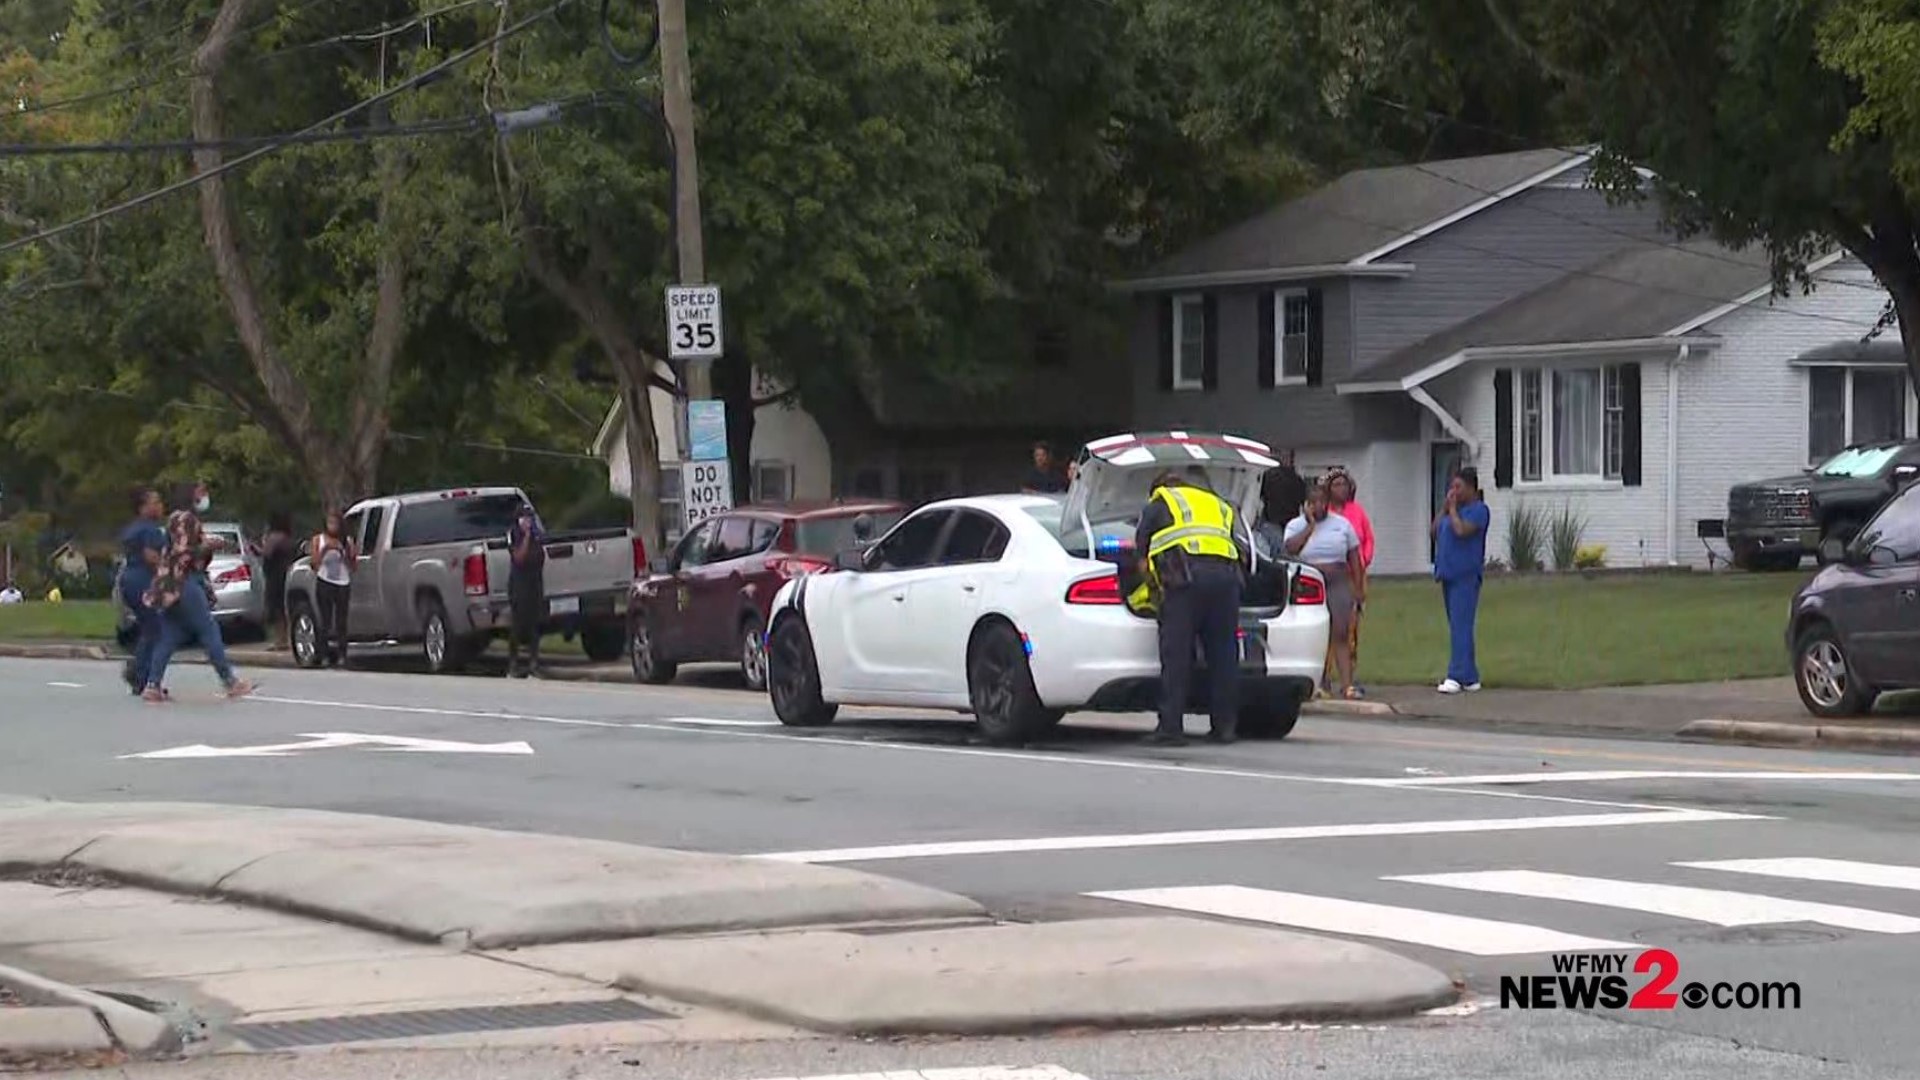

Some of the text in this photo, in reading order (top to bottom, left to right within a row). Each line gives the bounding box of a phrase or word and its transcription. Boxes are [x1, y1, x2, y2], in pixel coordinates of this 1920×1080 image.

[671, 293, 716, 306] SPEED
[676, 308, 711, 321] LIMIT
[676, 323, 716, 349] 35
[695, 466, 717, 483] DO
[691, 486, 722, 503] NOT
